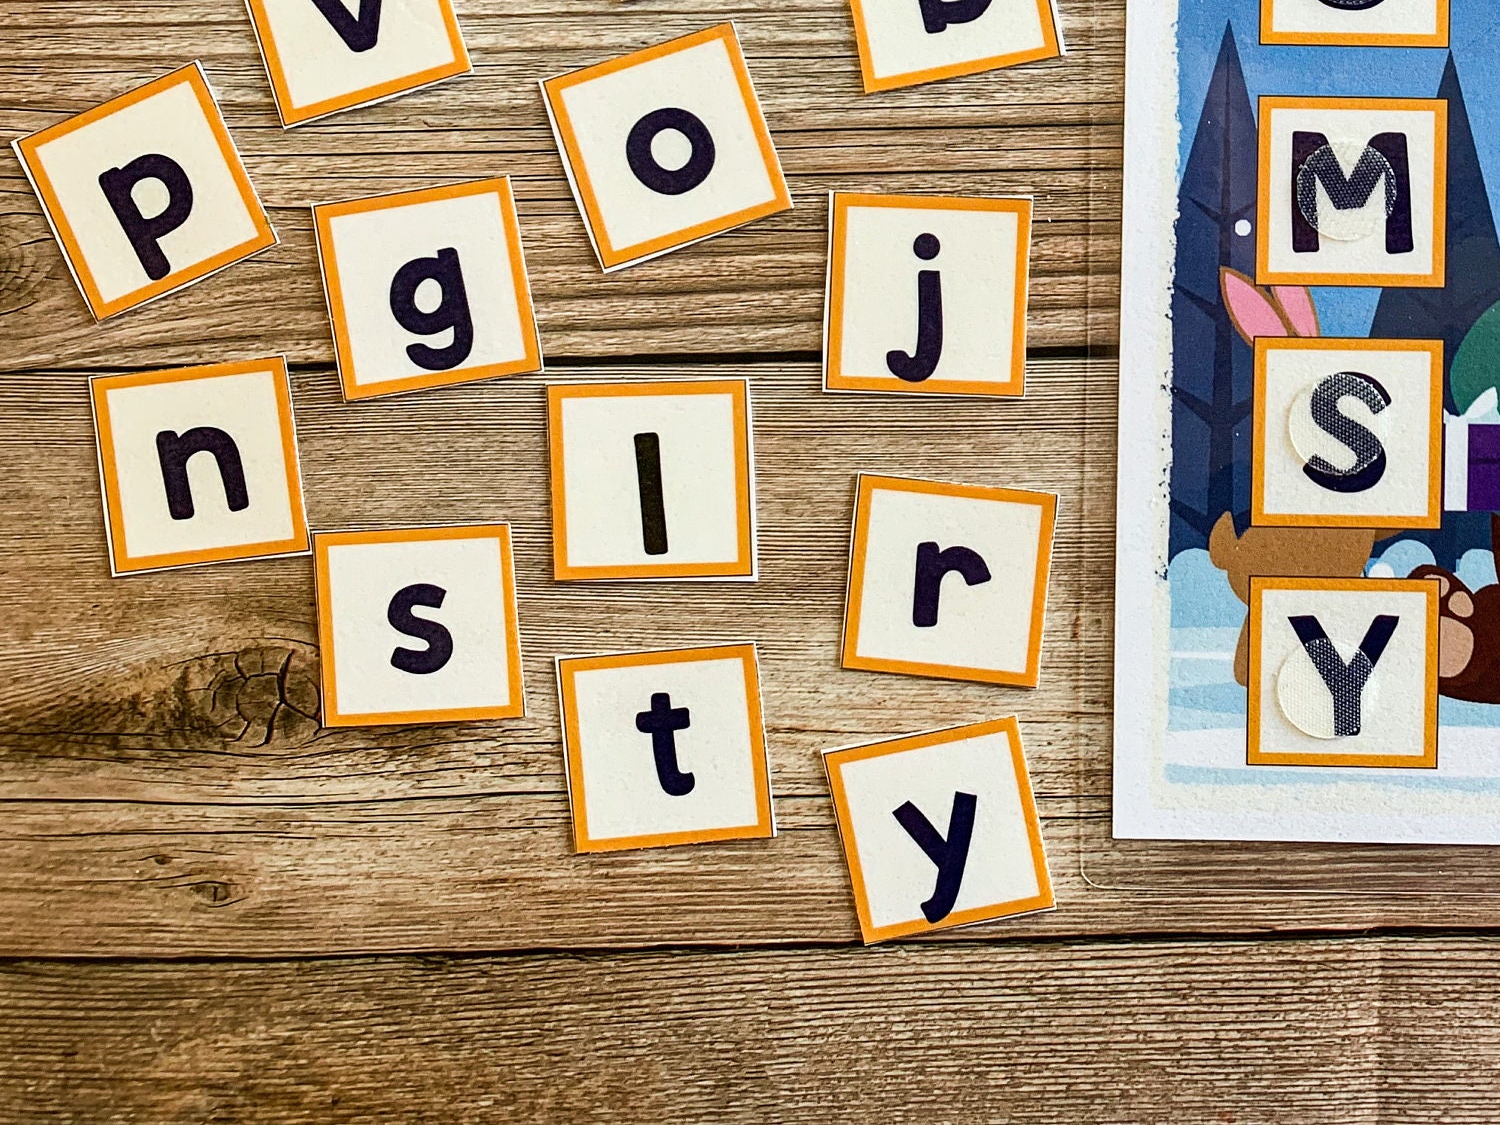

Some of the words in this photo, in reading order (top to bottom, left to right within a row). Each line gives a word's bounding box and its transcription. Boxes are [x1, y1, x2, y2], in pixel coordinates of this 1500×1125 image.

[626, 108, 715, 195] o
[1291, 131, 1414, 254] M
[99, 154, 193, 281] p
[390, 247, 473, 371] g
[886, 233, 943, 383] j
[156, 427, 249, 520] n
[1303, 372, 1391, 493] S
[388, 584, 453, 674] s
[913, 542, 991, 627] r
[1288, 615, 1399, 737] Y
[636, 693, 695, 796] t
[892, 791, 977, 923] y
